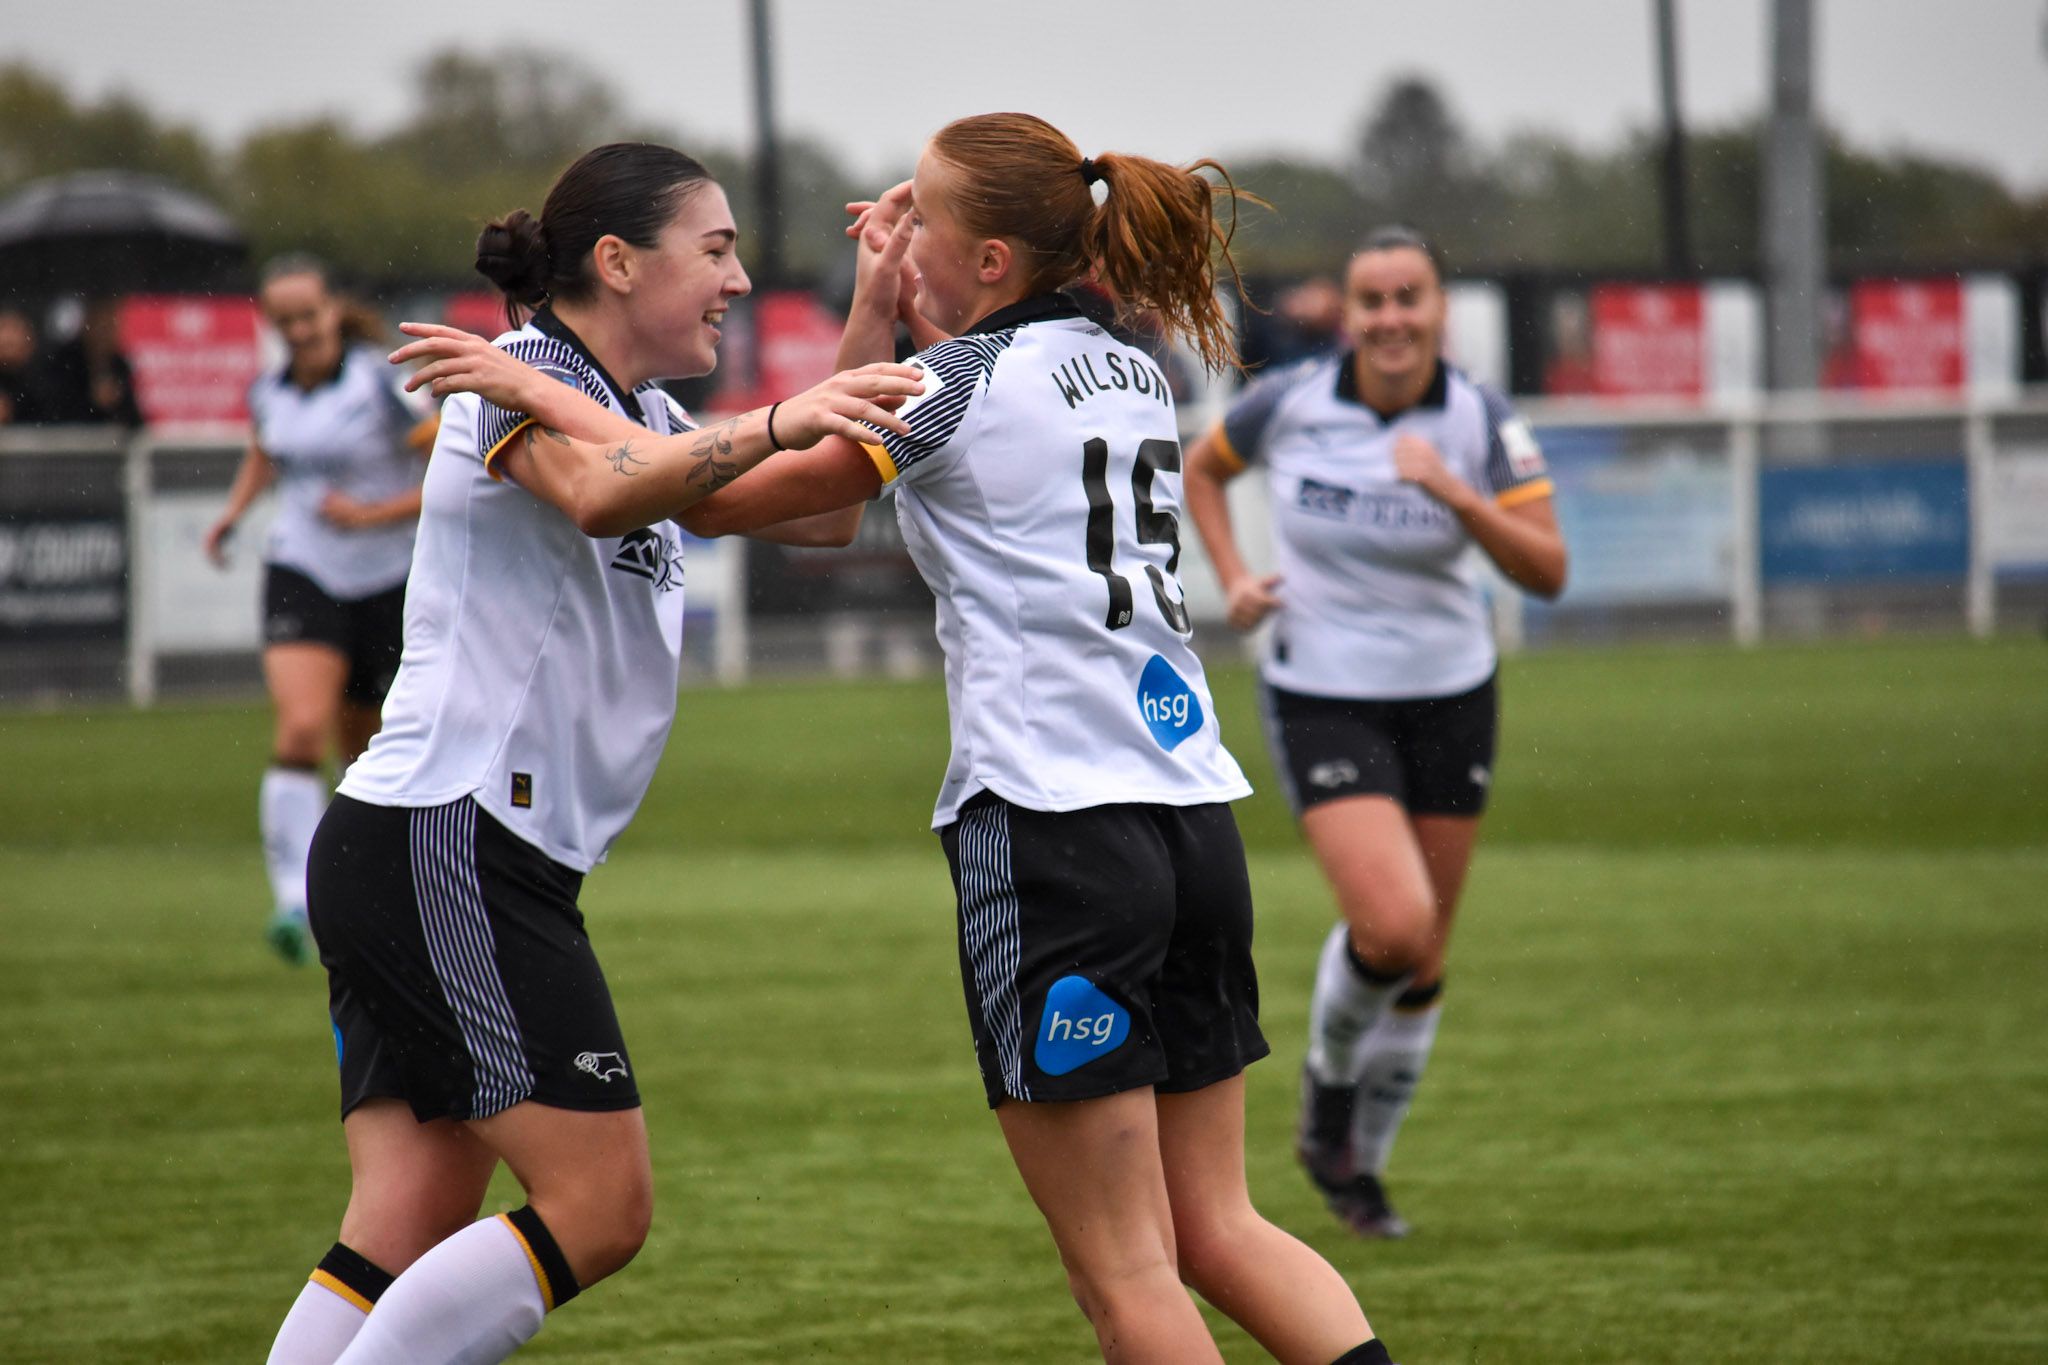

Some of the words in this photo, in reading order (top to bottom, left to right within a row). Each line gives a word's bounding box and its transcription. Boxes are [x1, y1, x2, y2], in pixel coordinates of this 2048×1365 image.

[1052, 352, 1168, 409] WILSON
[1082, 437, 1193, 633] 15
[1143, 691, 1189, 728] hsg
[1047, 1010, 1115, 1046] hsg
